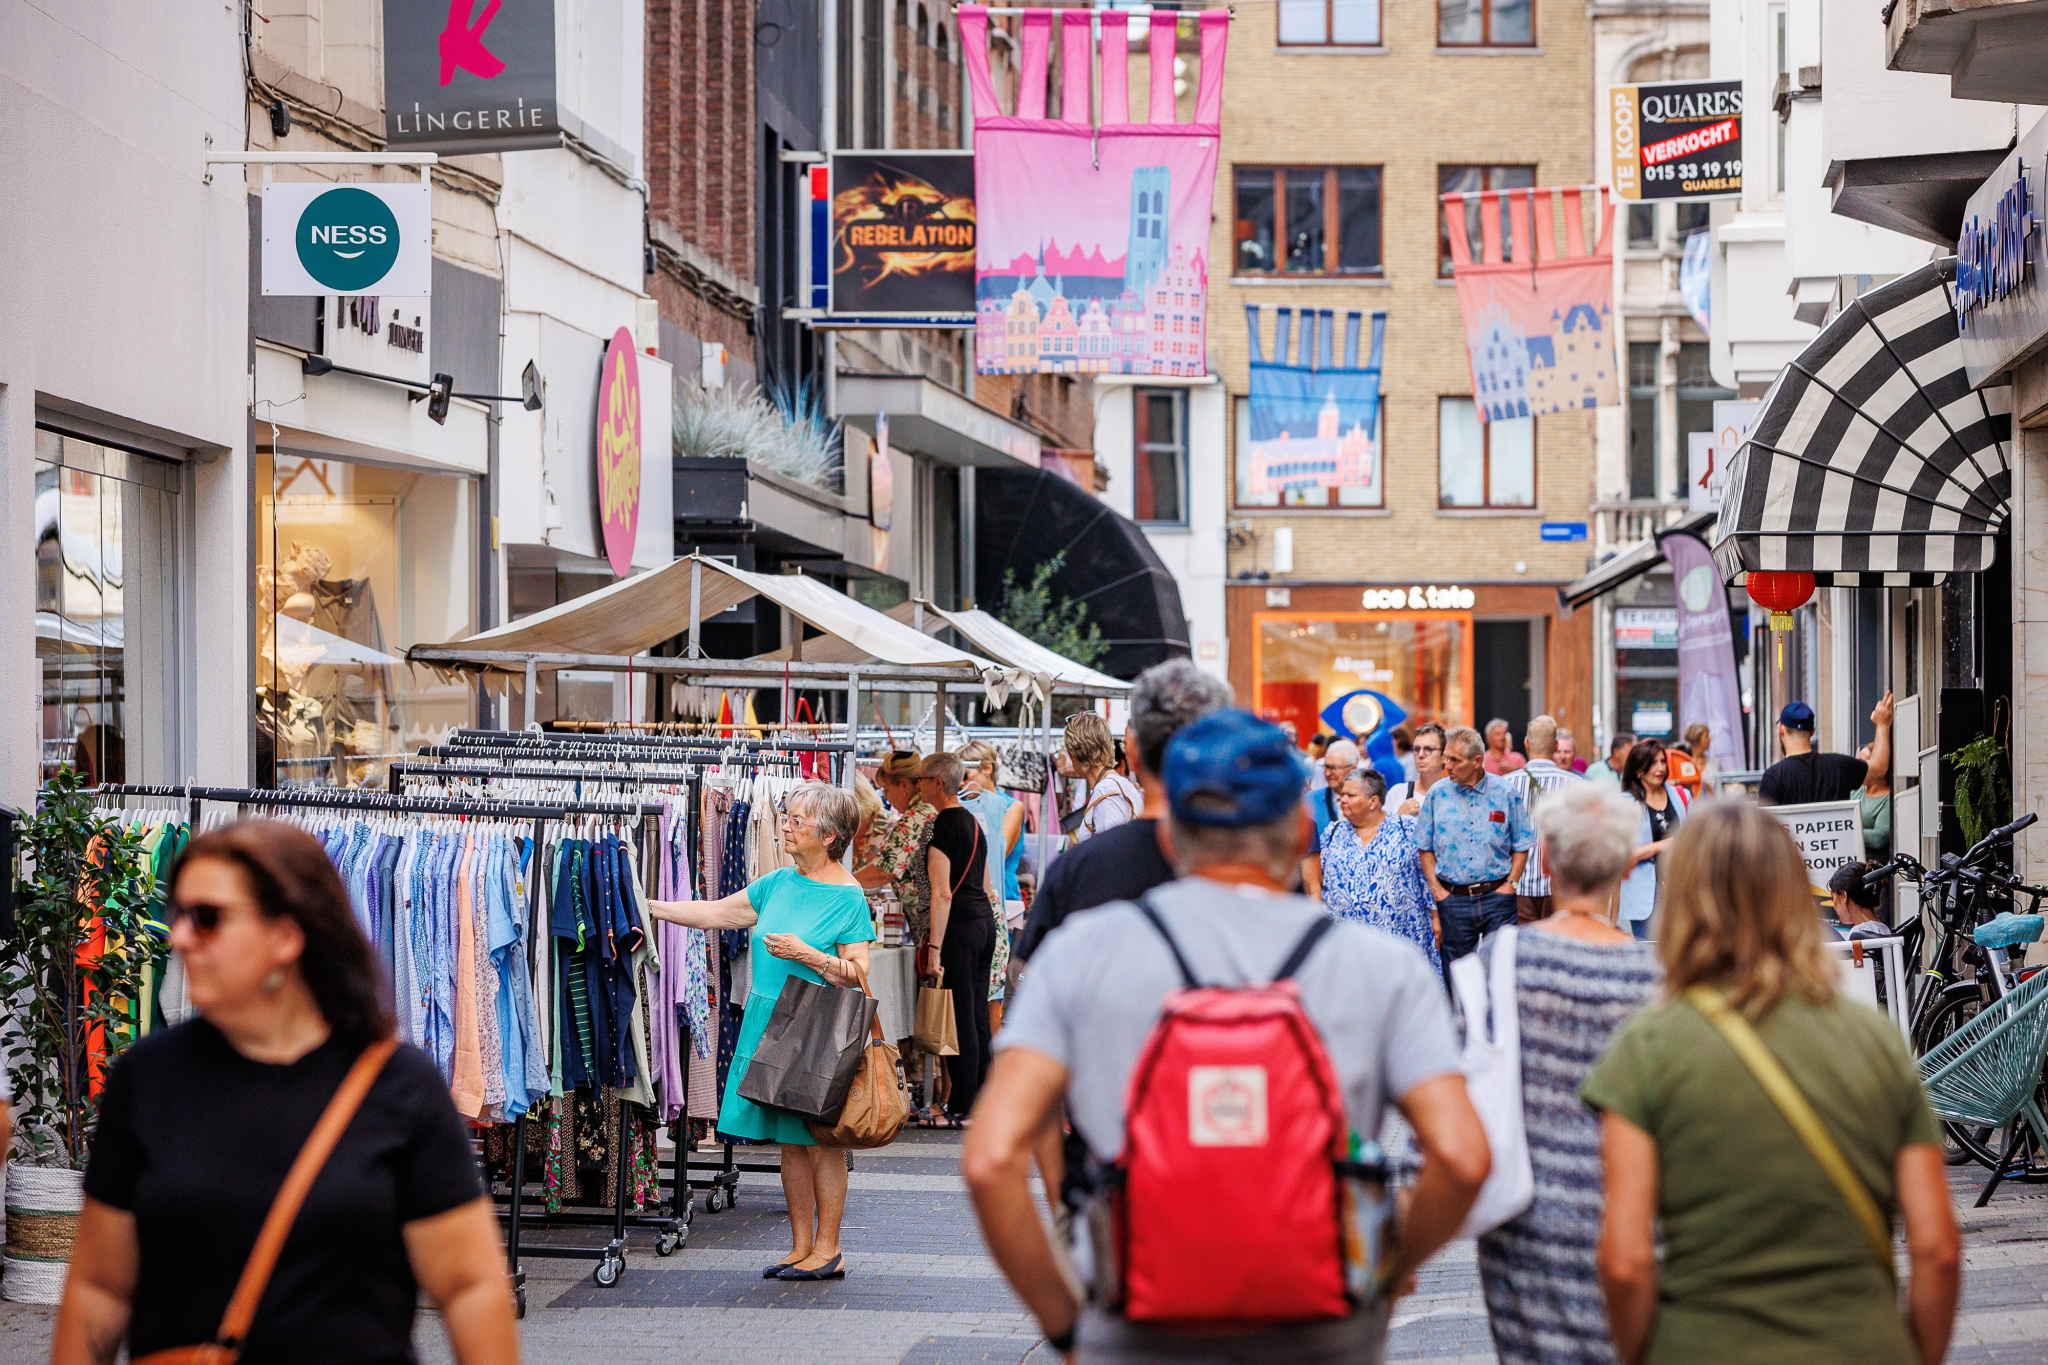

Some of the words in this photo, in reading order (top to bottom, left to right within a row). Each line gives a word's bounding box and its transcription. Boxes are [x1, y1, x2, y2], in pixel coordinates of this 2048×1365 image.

[1642, 90, 1742, 123] QUARES
[1614, 93, 1634, 159] KOOP
[1643, 121, 1732, 164] VERKOCHT
[1616, 165, 1634, 192] TE
[1645, 165, 1675, 181] 015
[1678, 163, 1698, 179] 33
[1702, 161, 1721, 178] 19
[1724, 160, 1742, 176] 19
[1682, 177, 1742, 191] QUARES.BE
[311, 225, 387, 245] NESS
[851, 224, 974, 246] REBELATION
[1407, 585, 1428, 610] &
[1795, 819, 1855, 834] PAPIER
[1810, 839, 1839, 852] SET
[1804, 855, 1858, 870] RONEN
